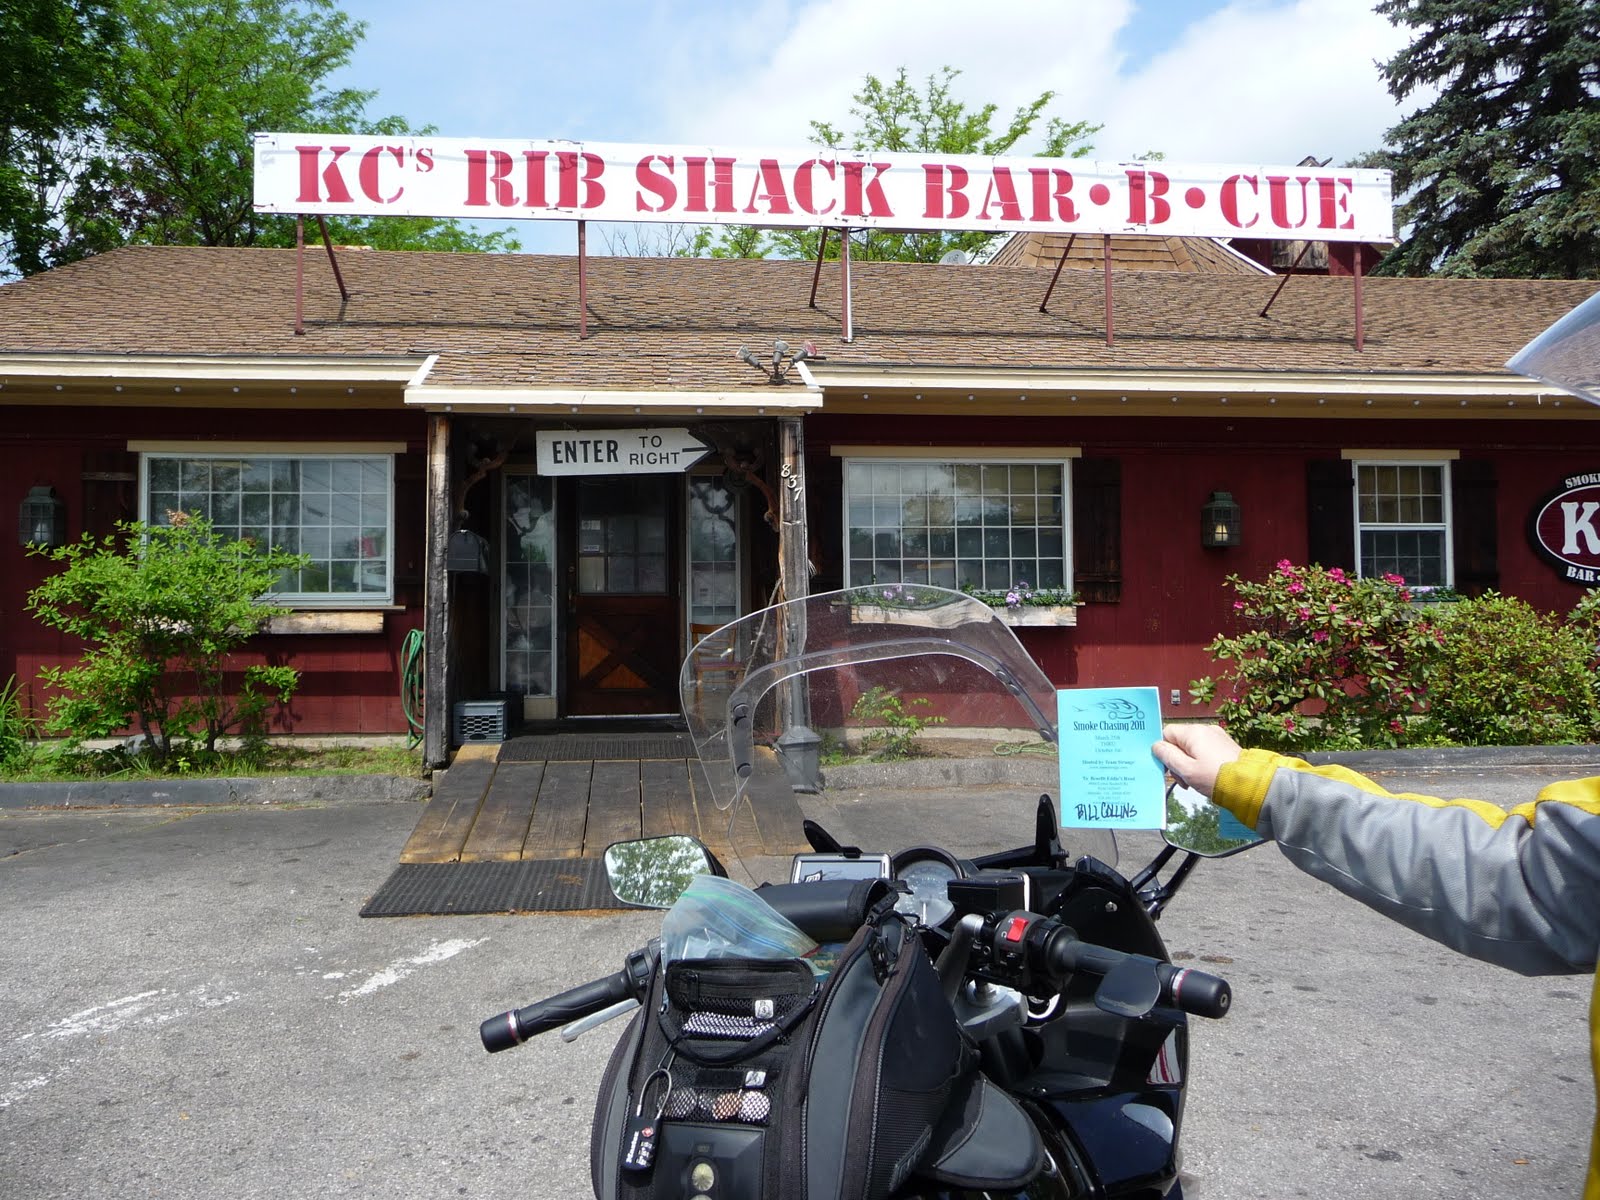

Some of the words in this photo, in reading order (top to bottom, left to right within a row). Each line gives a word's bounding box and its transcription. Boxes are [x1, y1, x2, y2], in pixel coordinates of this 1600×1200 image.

[464, 149, 606, 209] RIB
[635, 155, 895, 218] SHACK
[552, 439, 619, 464] ENTER
[638, 435, 663, 449] TO
[629, 452, 681, 466] RIGHT
[780, 463, 804, 502] 837
[1564, 472, 1600, 489] SMOK
[1073, 720, 1099, 731] Smoke
[1099, 720, 1130, 732] Chasing
[1130, 720, 1146, 731] 2011
[1074, 803, 1100, 821] BILL
[1100, 801, 1138, 819] COLLINS
